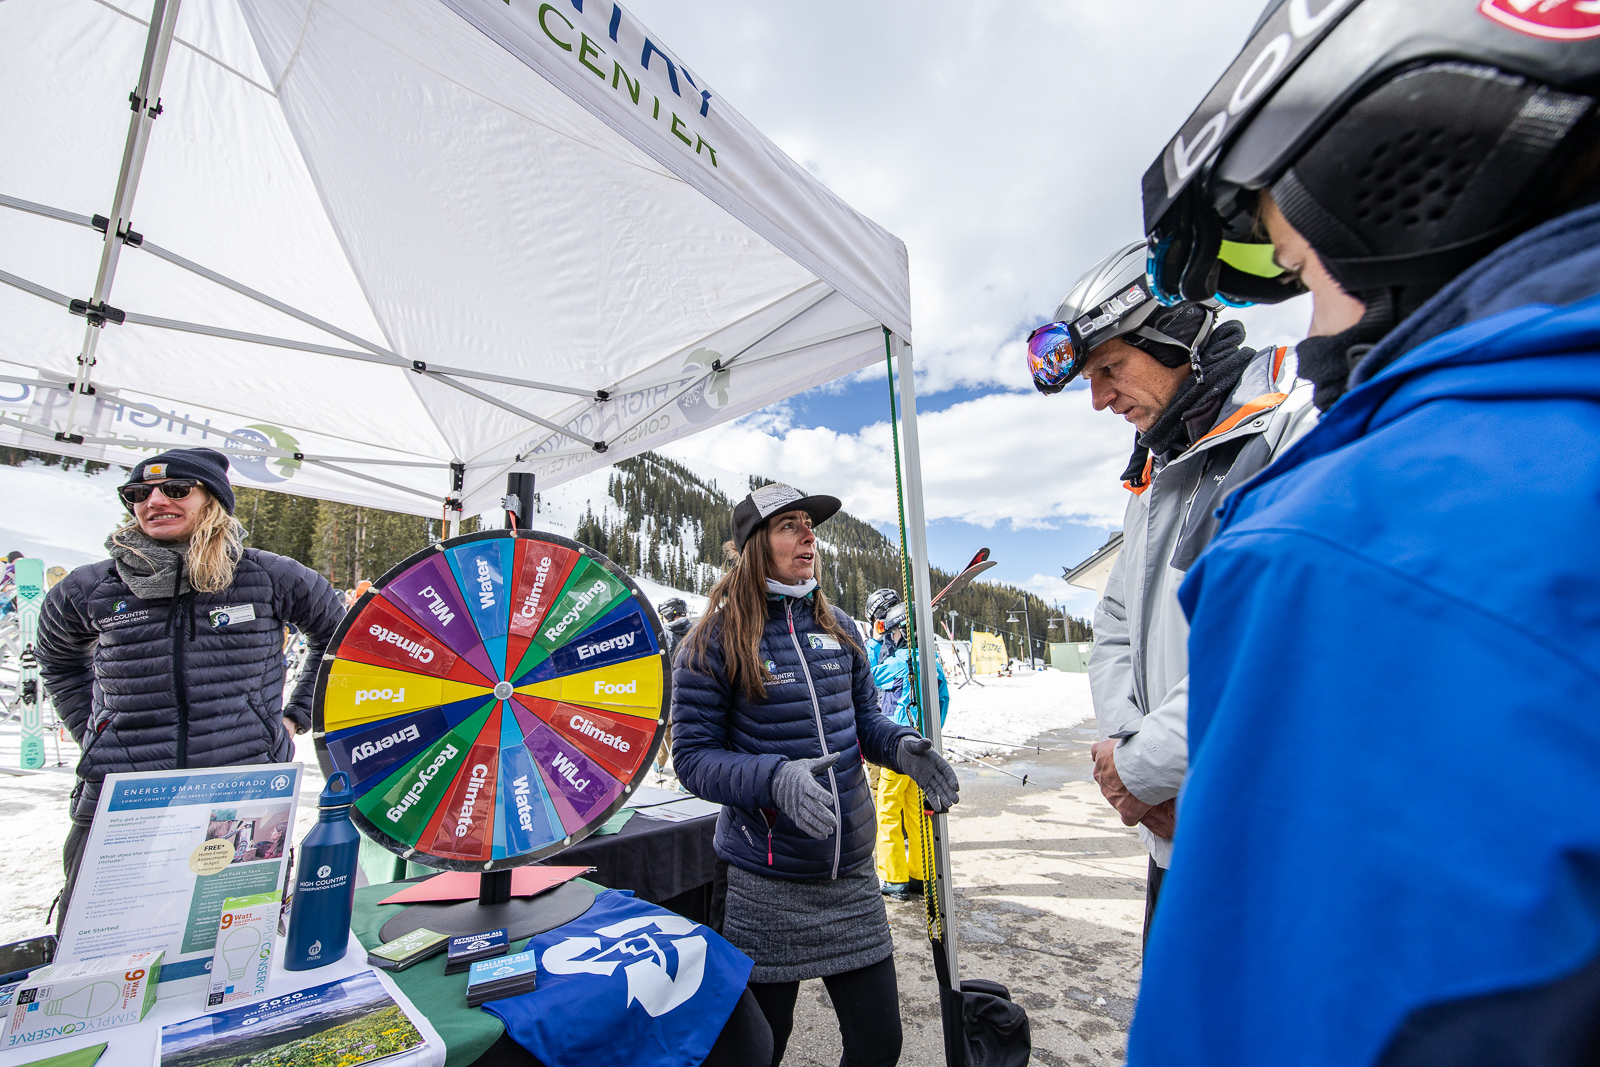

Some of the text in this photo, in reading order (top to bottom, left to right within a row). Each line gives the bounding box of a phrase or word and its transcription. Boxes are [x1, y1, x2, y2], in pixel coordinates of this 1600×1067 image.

[539, 3, 718, 168] CENTER
[476, 558, 496, 610] Water
[521, 556, 552, 618] Climate
[113, 609, 149, 621] COUNTRY
[544, 579, 607, 642] Recycling
[369, 624, 434, 664] Climate
[576, 631, 635, 660] Energy
[594, 680, 637, 694] Food
[355, 688, 405, 705] Food
[569, 715, 631, 753] Climate
[351, 724, 421, 765] Energy
[123, 779, 267, 796] ENERGY SMART COLORADO
[386, 743, 459, 824] Recycling
[455, 763, 489, 838] Climate
[512, 774, 533, 832] Water
[315, 875, 348, 887] COUNTRY
[221, 913, 234, 930] 9
[234, 912, 253, 920] Watt
[92, 925, 120, 934] Started
[400, 930, 425, 942] YOU
[453, 933, 491, 942] ATTENTION
[476, 957, 513, 969] CALLING
[476, 957, 530, 972] NATURE LOVERS
[125, 969, 145, 981] 9
[130, 980, 140, 999] Watt
[244, 1004, 282, 1017] ANNUAL
[285, 993, 318, 1005] REPORT
[259, 992, 303, 1009] 2020
